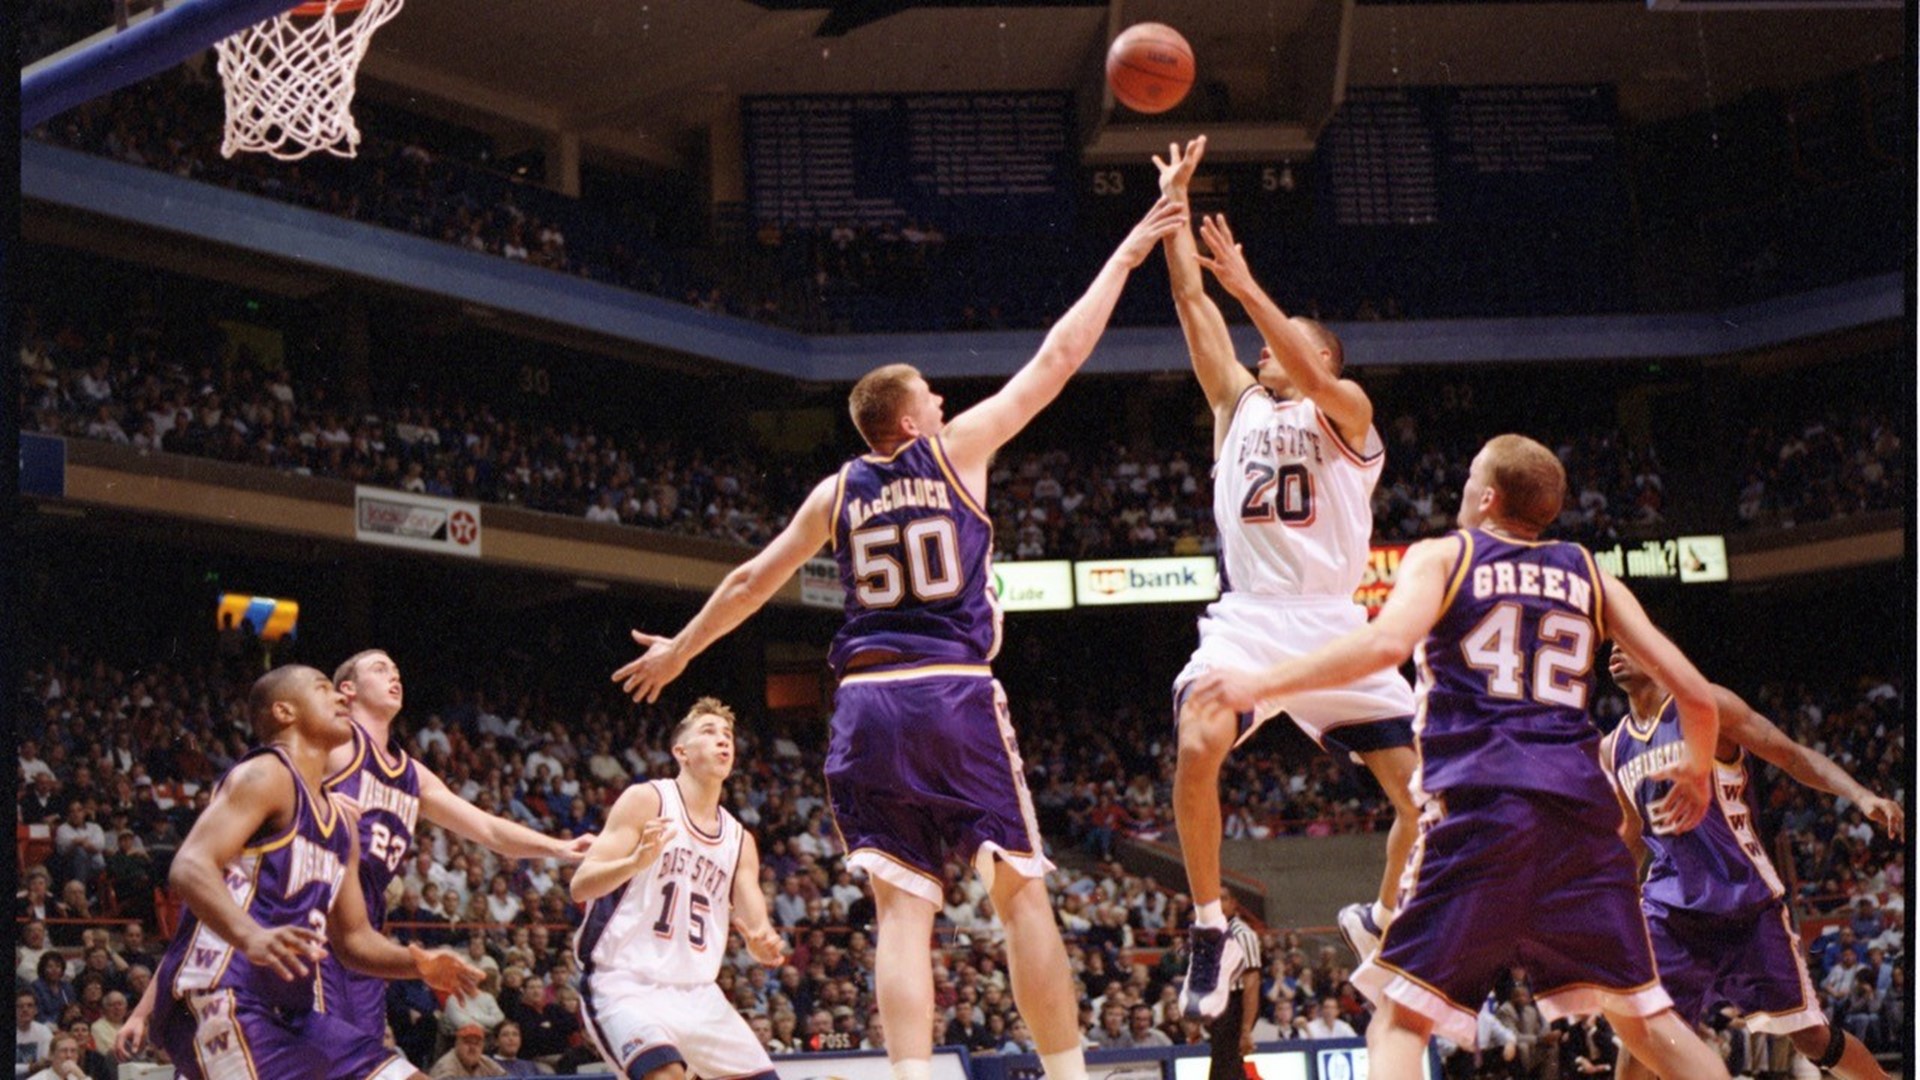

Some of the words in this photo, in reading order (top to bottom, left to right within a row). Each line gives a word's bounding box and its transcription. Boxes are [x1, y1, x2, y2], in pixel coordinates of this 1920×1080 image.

[1093, 171, 1124, 195] 53
[1262, 168, 1294, 191] 54
[1240, 460, 1317, 529] 20
[850, 514, 964, 610] 50
[1626, 540, 1677, 577] milk?
[1129, 566, 1197, 589] bank
[1472, 561, 1592, 616] GREEN
[1459, 600, 1596, 710] 42
[1722, 784, 1742, 801] W
[369, 822, 407, 873] 23
[652, 881, 711, 952] 15
[195, 948, 223, 969] W
[204, 1031, 231, 1055] W
